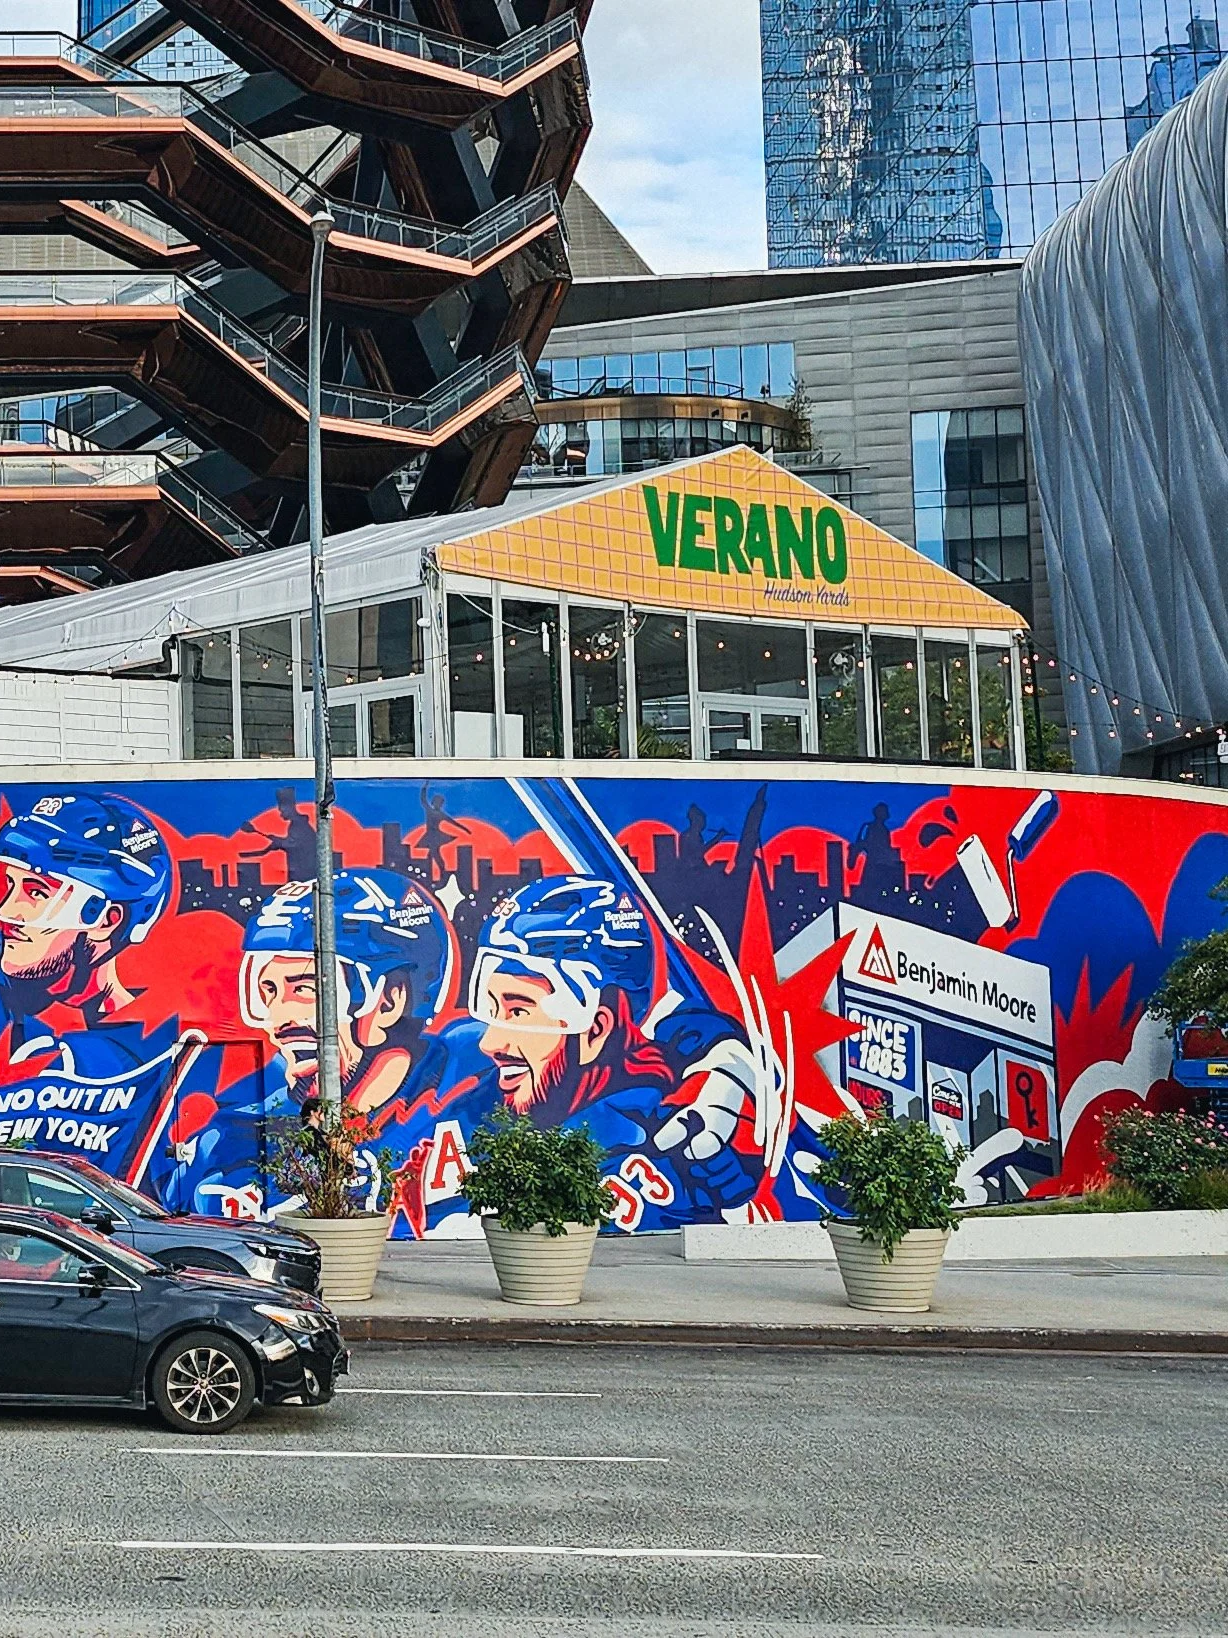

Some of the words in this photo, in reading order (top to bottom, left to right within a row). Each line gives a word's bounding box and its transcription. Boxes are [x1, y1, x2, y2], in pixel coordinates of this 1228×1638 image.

[642, 484, 848, 585] VERANO
[763, 580, 812, 604] Hudson
[816, 584, 851, 607] Yards
[389, 904, 434, 921] Benjamin
[603, 909, 644, 923] Benjamin
[897, 950, 978, 1004] Benjamin
[981, 980, 1037, 1023] Moore
[859, 1041, 907, 1080] 1883
[36, 1085, 102, 1112] QUIT
[98, 1086, 137, 1113] IN
[45, 1116, 120, 1153] YORK
